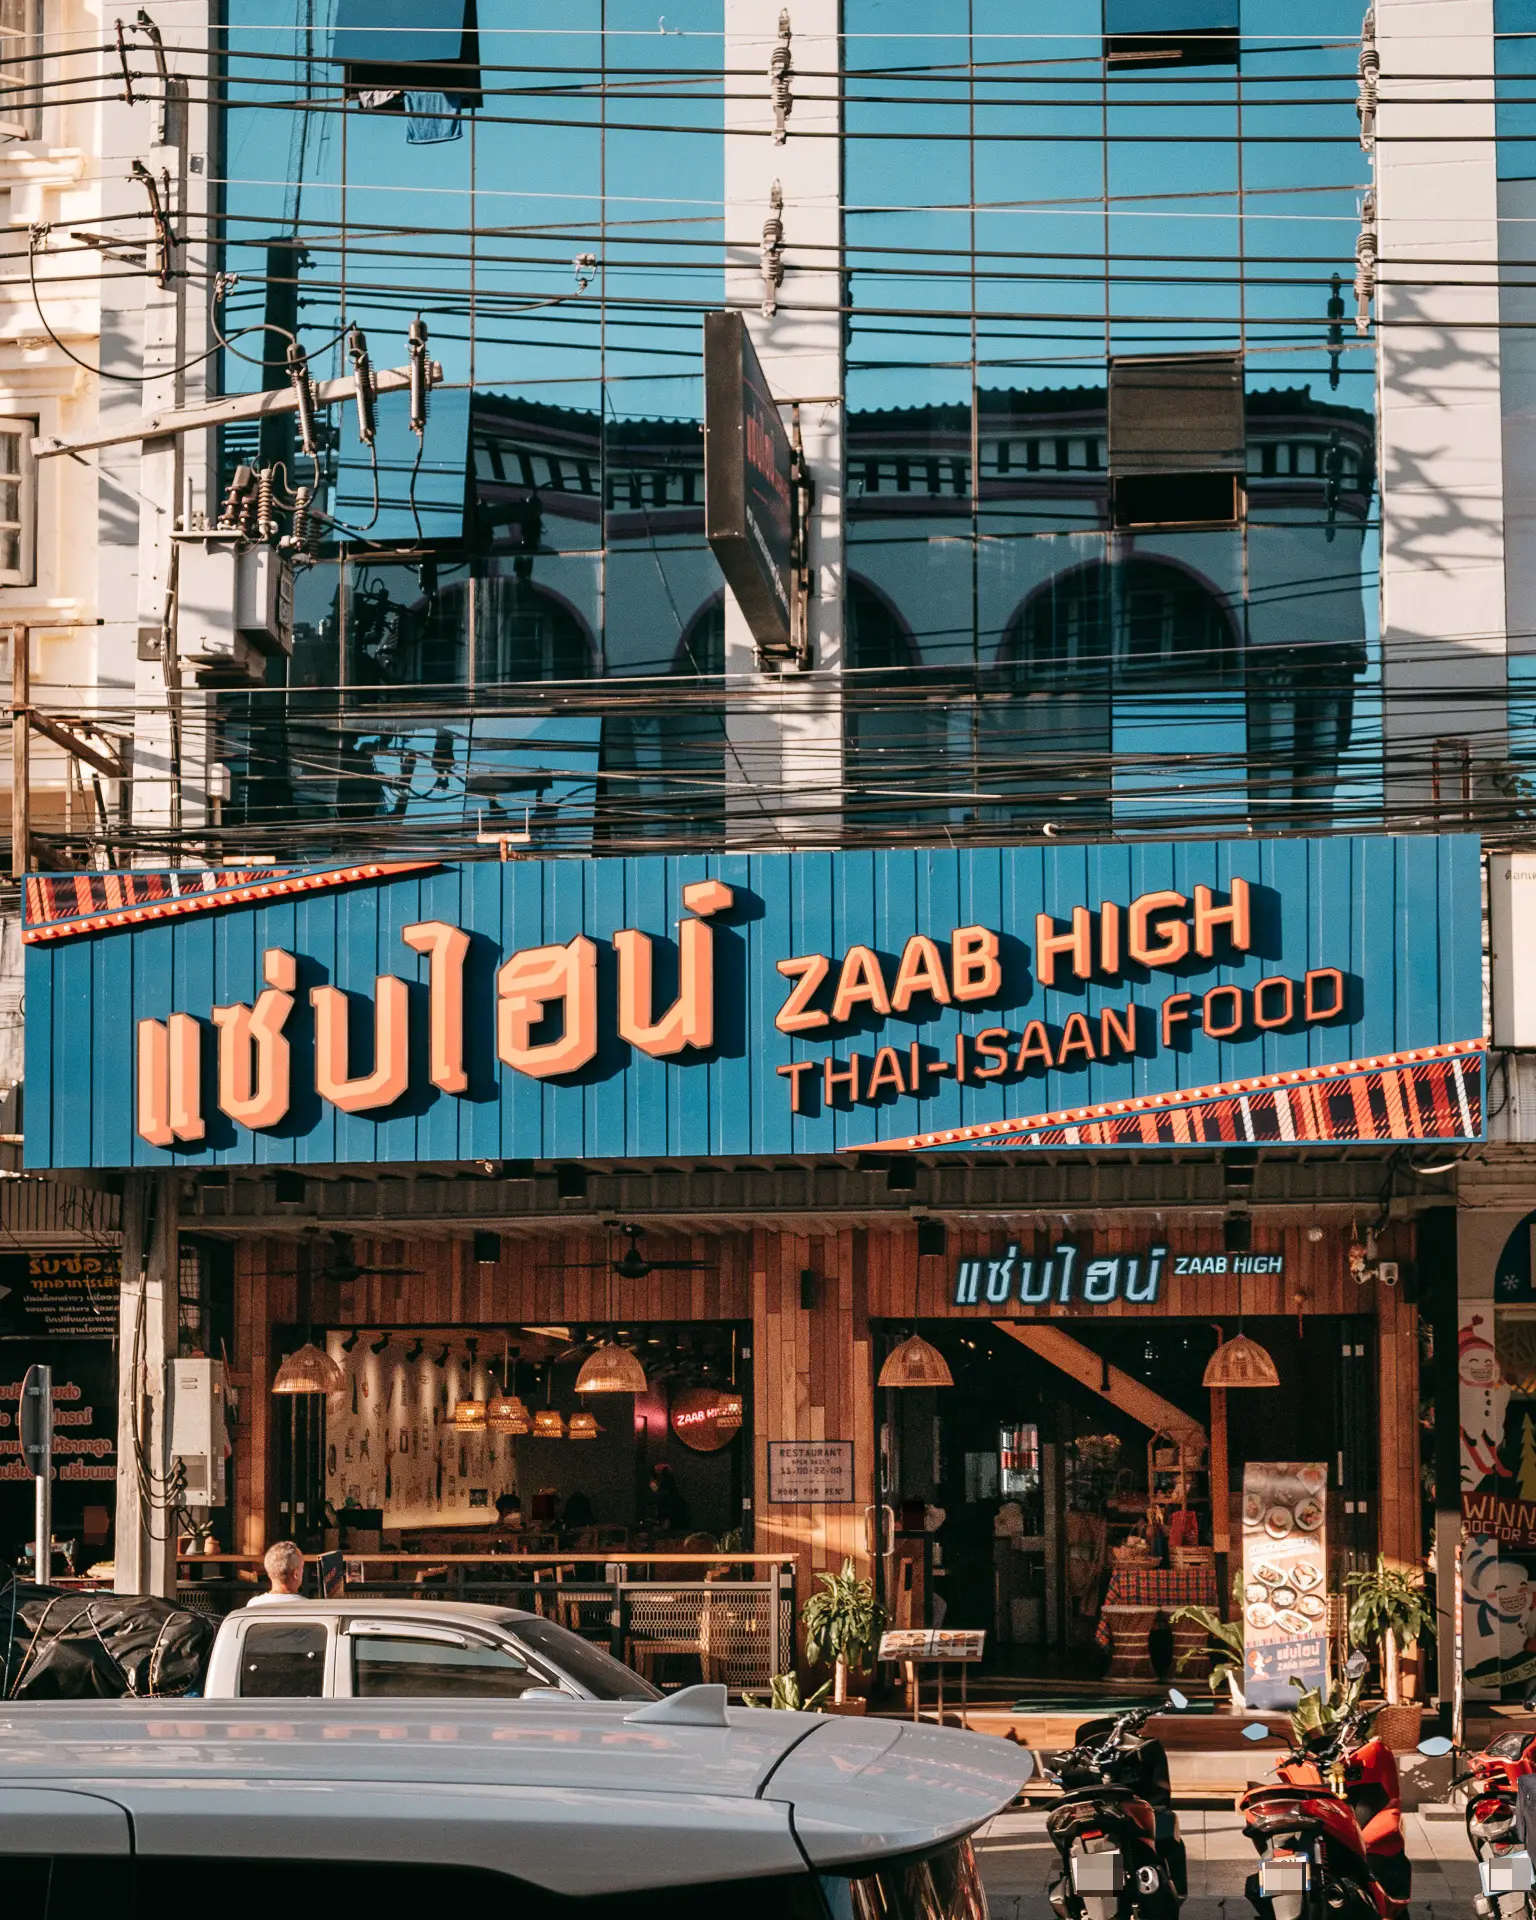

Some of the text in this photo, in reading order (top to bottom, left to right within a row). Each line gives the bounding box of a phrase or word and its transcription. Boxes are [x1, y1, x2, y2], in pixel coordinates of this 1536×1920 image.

[775, 877, 1251, 1033] ZAAB HIGH
[776, 967, 1345, 1113] THAI-ISAAN FOOD
[1174, 1256, 1227, 1275] ZAAB
[1233, 1256, 1283, 1274] HIGH
[677, 1409, 705, 1426] ZAAB
[779, 1448, 843, 1458] RESTAURANT
